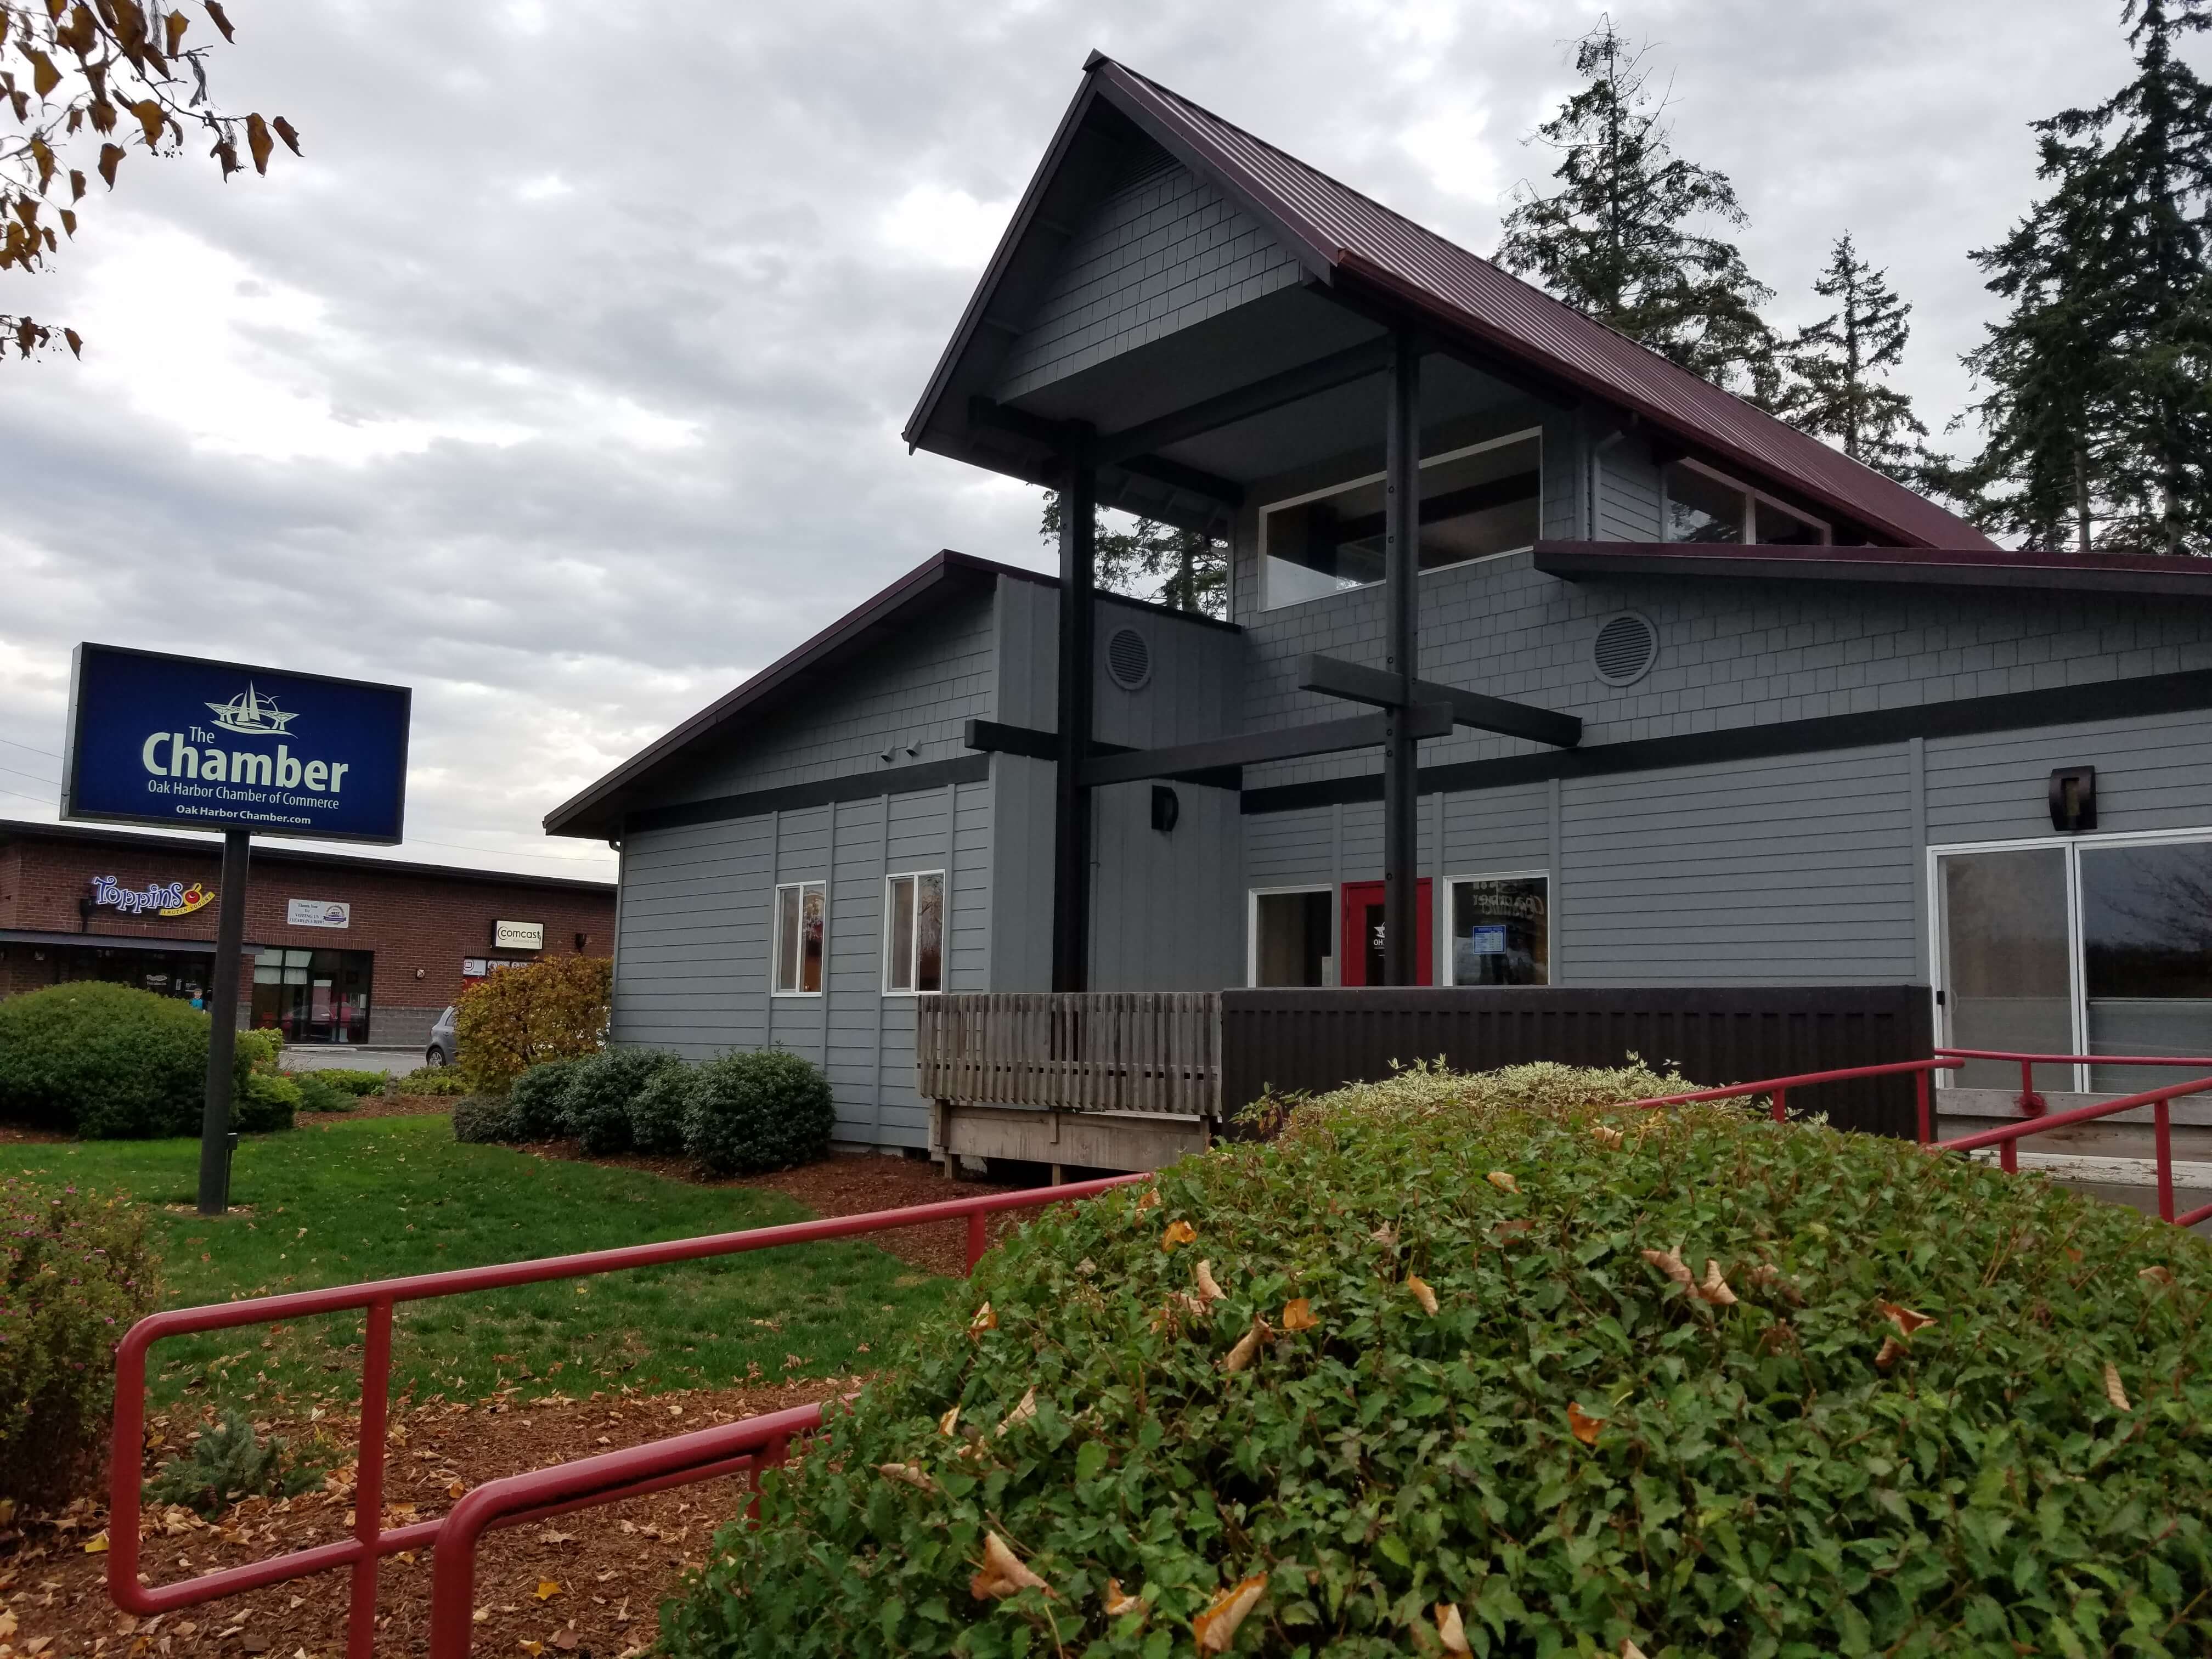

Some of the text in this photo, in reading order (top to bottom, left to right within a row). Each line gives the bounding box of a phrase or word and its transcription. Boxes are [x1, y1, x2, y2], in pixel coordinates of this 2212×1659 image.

[189, 726, 215, 743] The
[143, 732, 349, 793] Chamber
[148, 780, 339, 809] Oak Harbor Chamber of Commerce
[176, 805, 311, 825] Oak Harbor Chamber.com
[94, 876, 183, 913] Toppins
[190, 894, 213, 910] YOGURT
